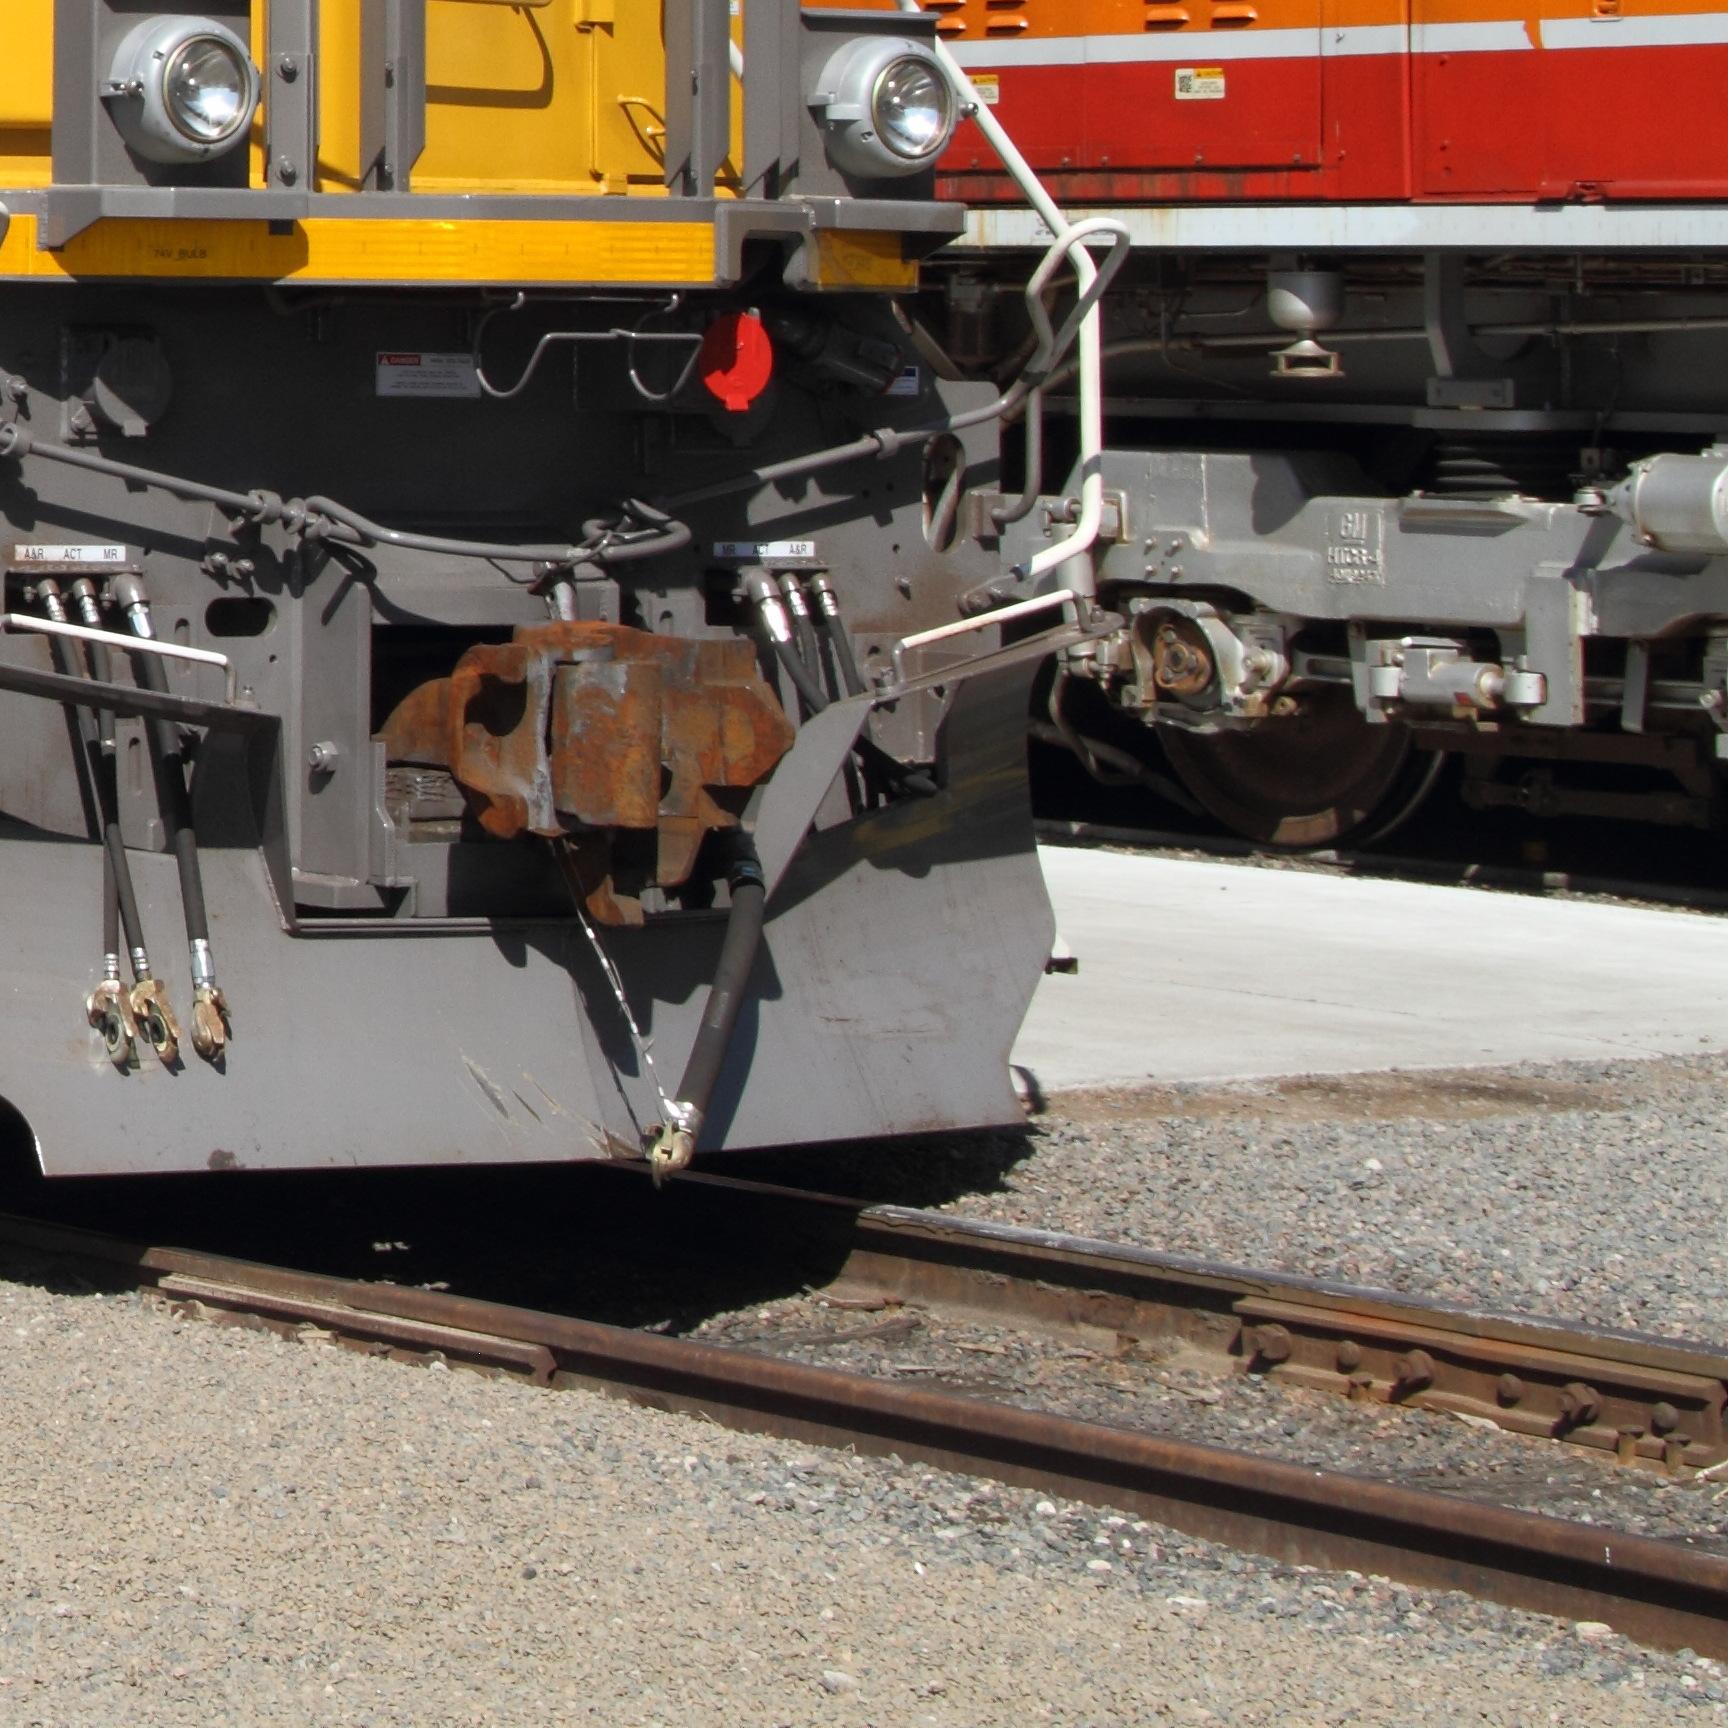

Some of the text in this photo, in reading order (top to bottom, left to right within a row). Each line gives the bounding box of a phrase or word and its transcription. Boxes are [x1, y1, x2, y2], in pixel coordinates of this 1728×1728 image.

[24, 547, 118, 560] A&R ACT MR
